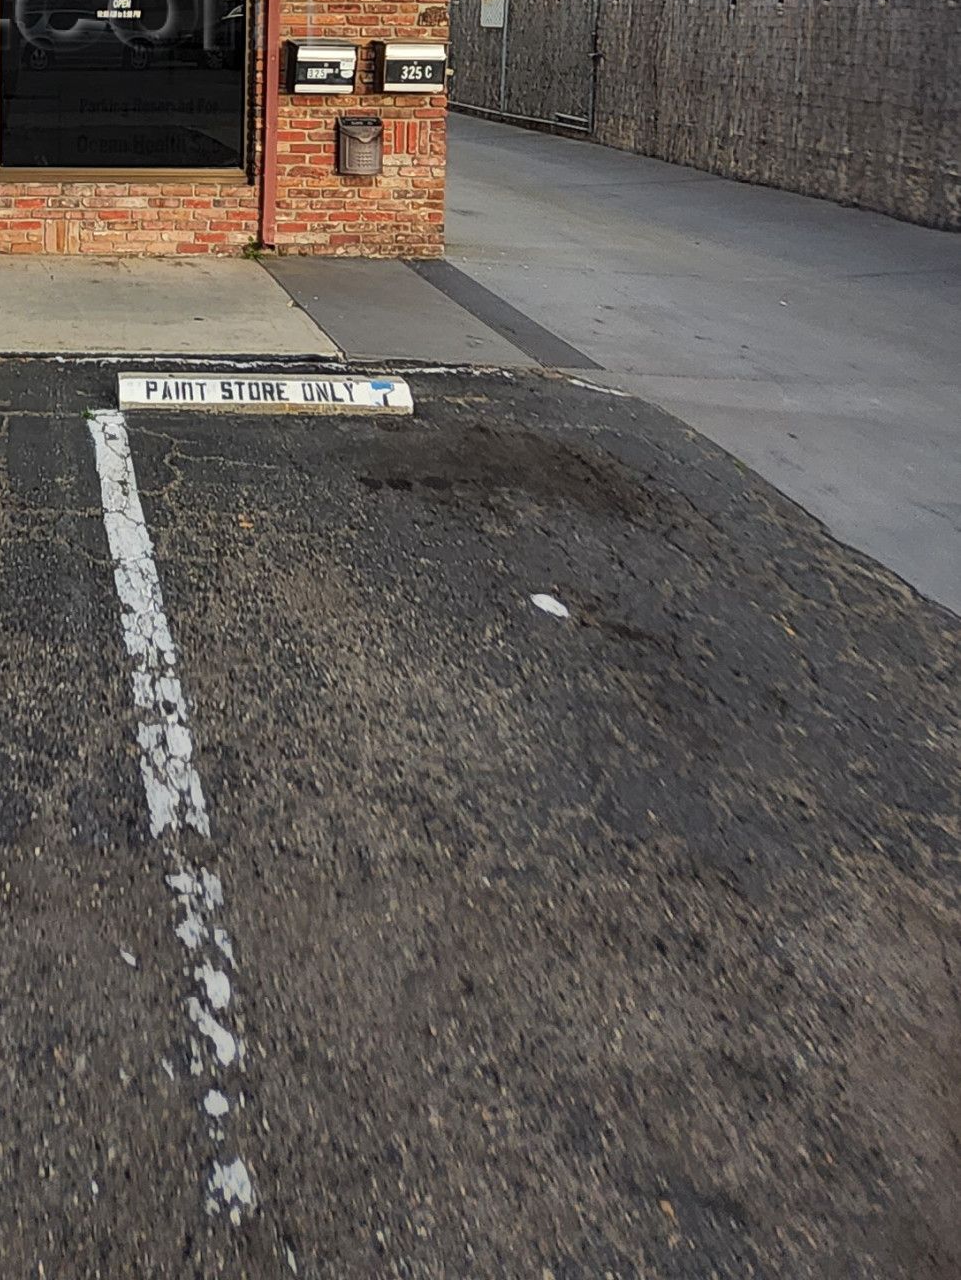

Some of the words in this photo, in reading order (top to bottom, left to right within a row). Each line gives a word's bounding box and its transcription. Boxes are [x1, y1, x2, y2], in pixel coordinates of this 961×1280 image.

[113, 0, 132, 8] OPEN
[401, 65, 423, 80] 325
[424, 65, 433, 79] C
[145, 380, 208, 401] PAINT
[221, 381, 288, 402] STORE
[301, 382, 357, 404] ONLY
